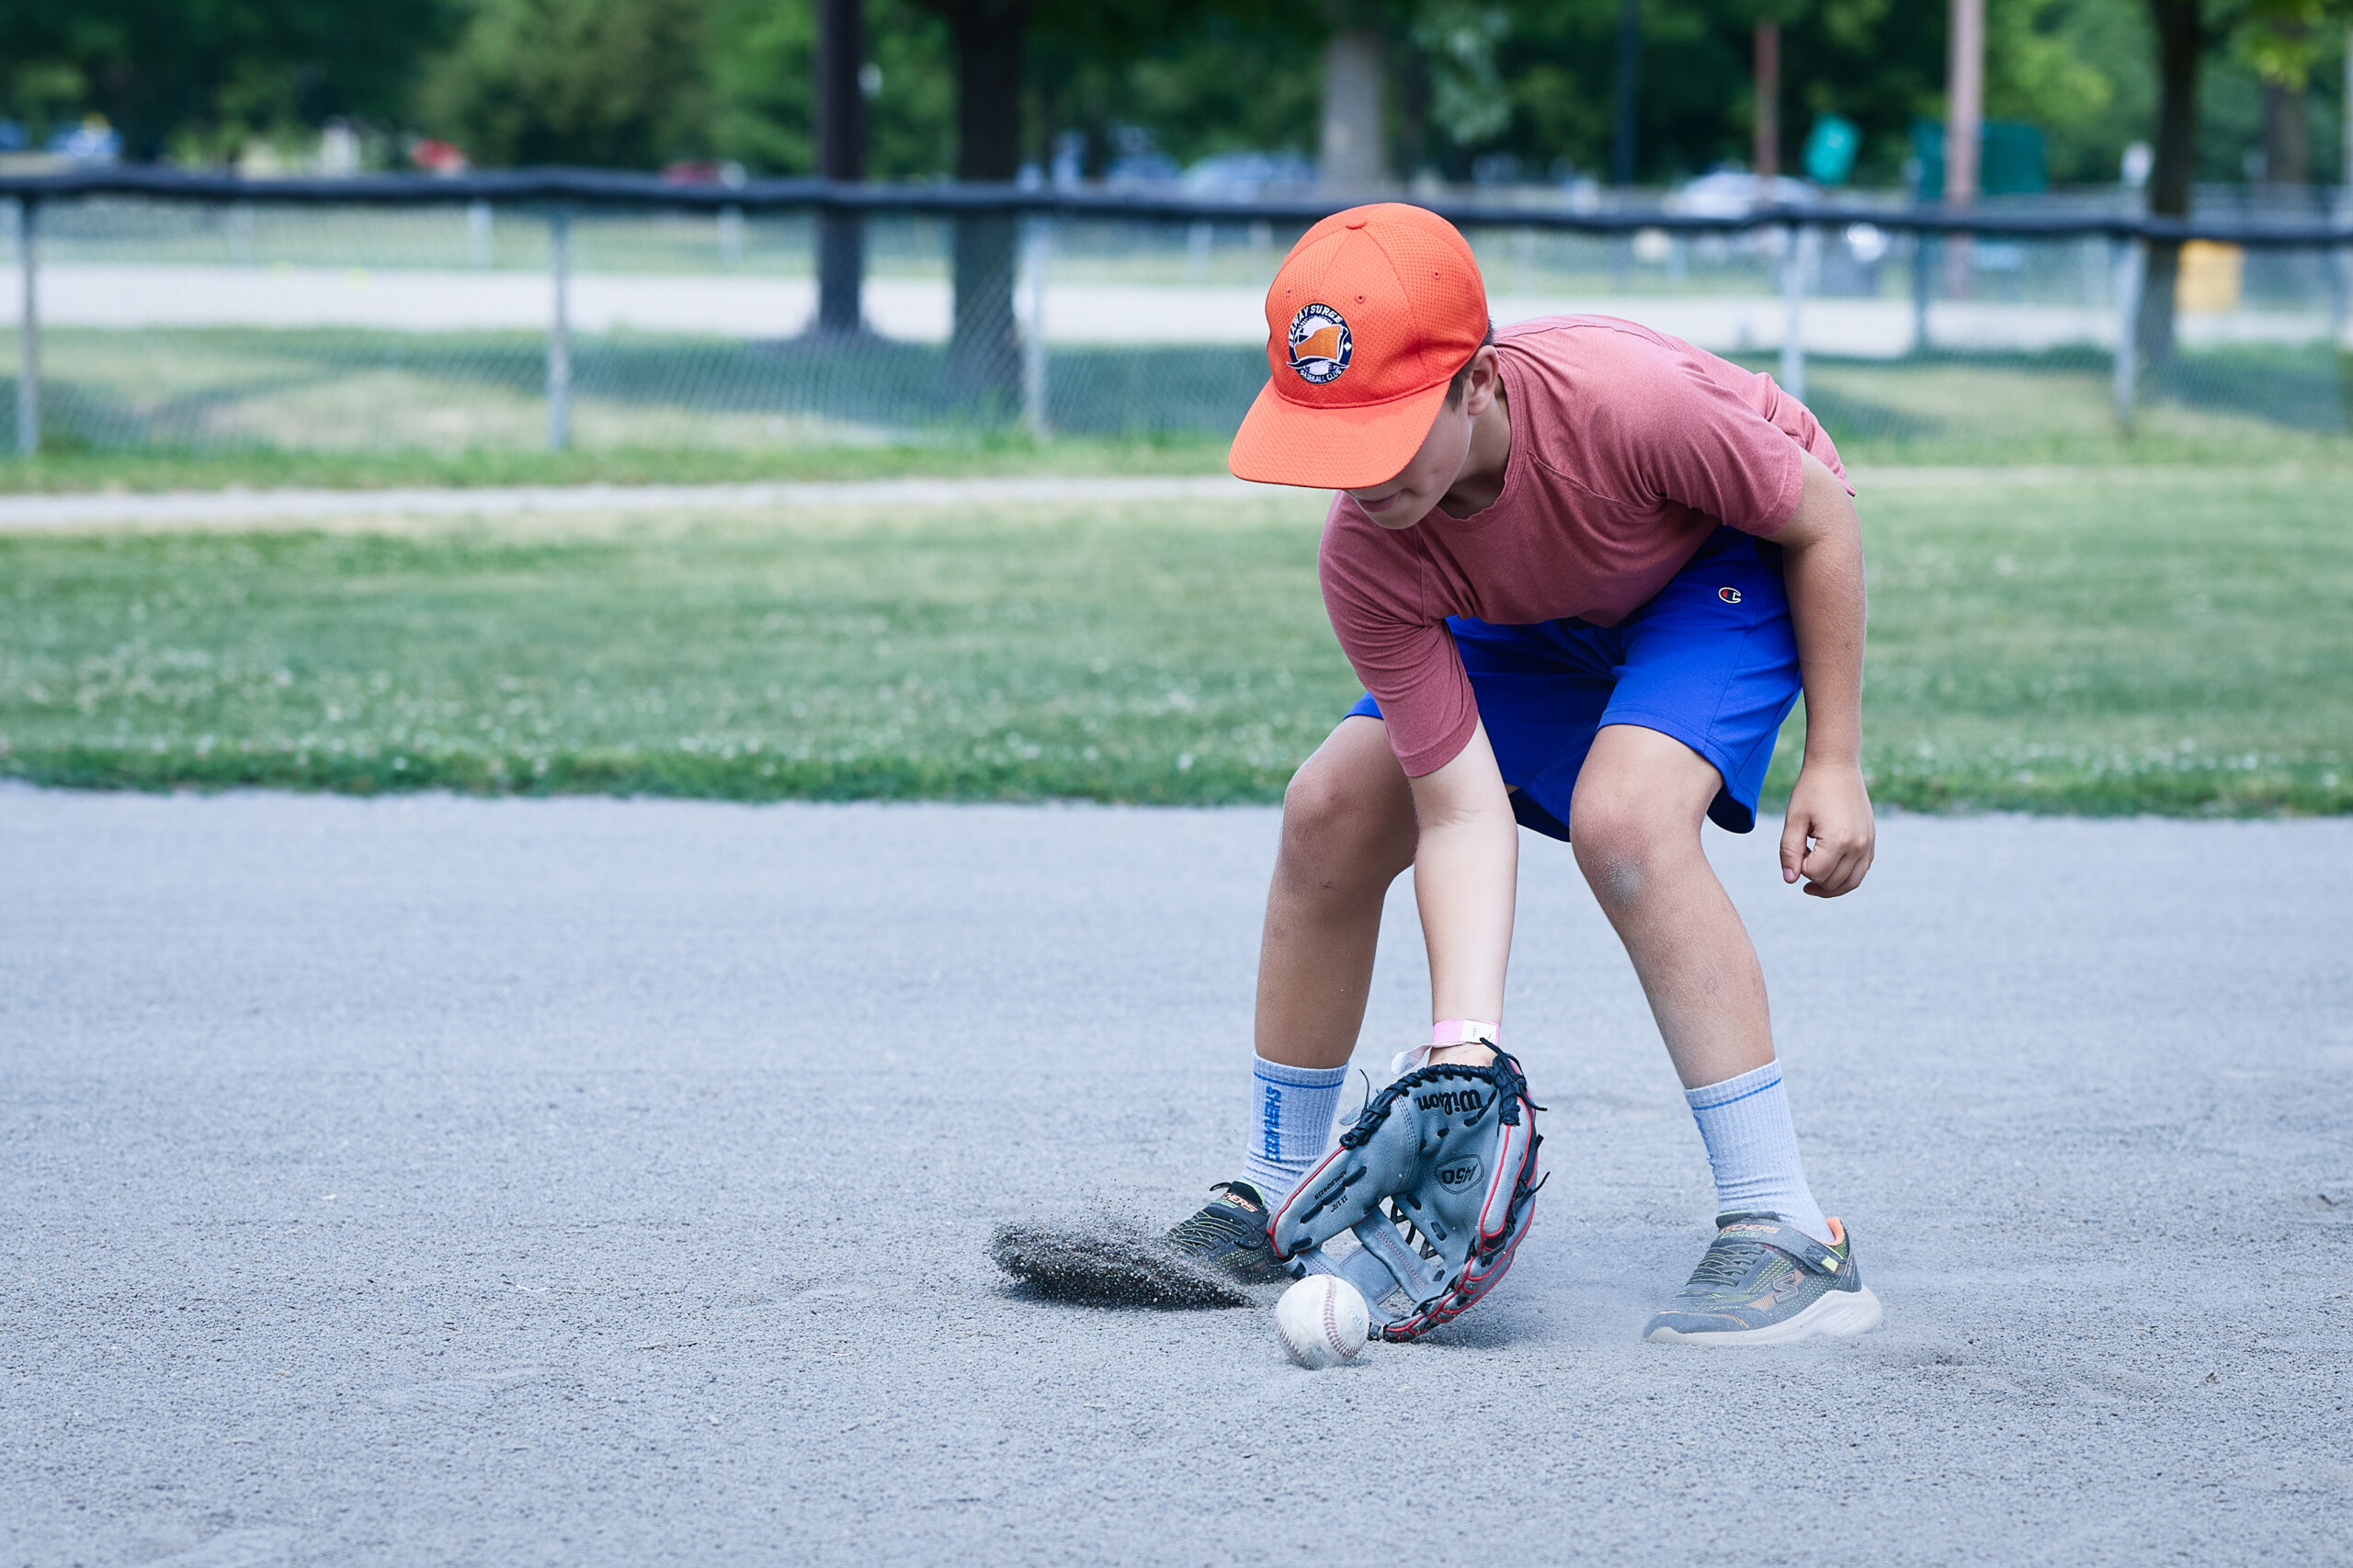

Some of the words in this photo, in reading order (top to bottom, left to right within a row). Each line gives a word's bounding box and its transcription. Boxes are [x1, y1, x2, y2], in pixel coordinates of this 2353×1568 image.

[1288, 306, 1309, 348] SEAWAY
[1310, 304, 1343, 323] SURGE
[1326, 368, 1342, 381] CLUB
[1416, 1089, 1483, 1117] Wilson
